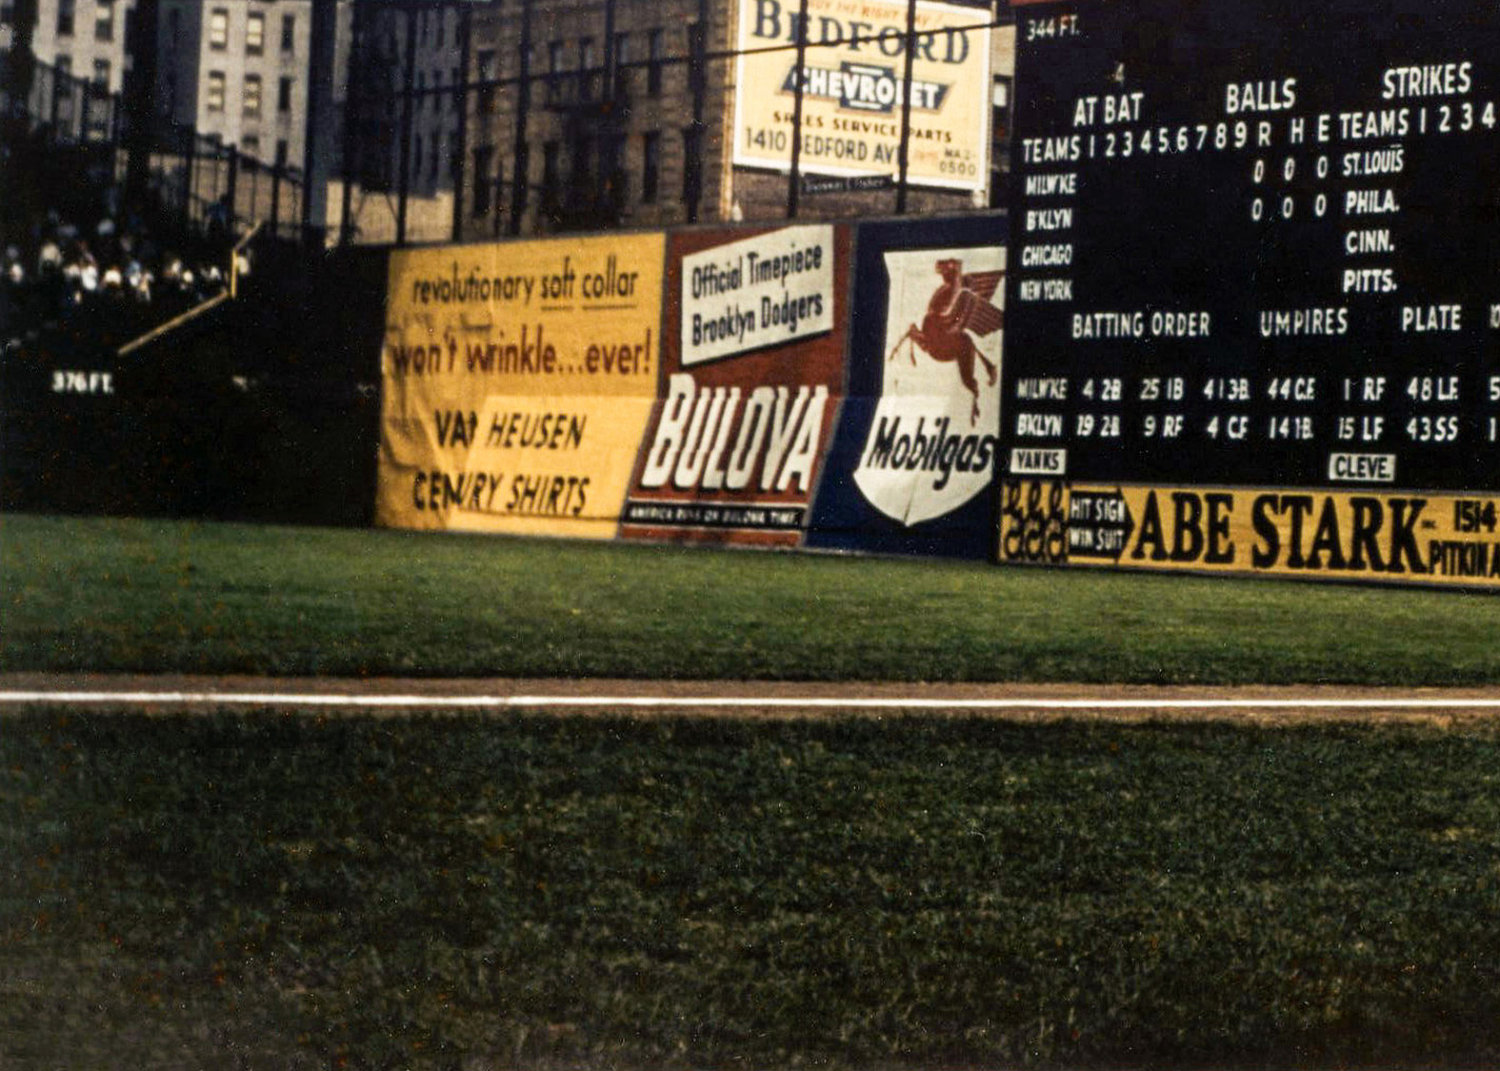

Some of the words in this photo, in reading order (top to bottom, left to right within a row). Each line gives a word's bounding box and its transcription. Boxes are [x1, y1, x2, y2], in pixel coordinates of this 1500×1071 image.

[1026, 18, 1056, 42] 344
[1225, 77, 1297, 114] BALLS
[1381, 61, 1472, 100] STRIKES
[832, 117, 898, 138] SERVICE
[1073, 96, 1098, 127] AT
[1104, 92, 1144, 125] BAT
[1339, 107, 1410, 139] TEAMS
[1420, 107, 1427, 134] 1
[1438, 105, 1451, 133] 2
[1460, 102, 1473, 131] 3
[1481, 101, 1496, 129] 4
[745, 127, 787, 153] 1410
[798, 134, 869, 162] EDFORD
[1022, 135, 1081, 163] TEAMS
[1089, 134, 1095, 158] 1
[1105, 132, 1116, 157] 2
[1122, 130, 1133, 157] 3
[1140, 129, 1152, 153] 4
[1158, 127, 1170, 152] 5
[1176, 126, 1189, 152] 6
[1196, 124, 1208, 150] 7
[1214, 122, 1227, 150] 8
[1234, 121, 1248, 149] 9
[1258, 121, 1272, 147] R
[1290, 117, 1305, 144] H
[1317, 113, 1331, 142] E
[1345, 189, 1400, 215] PHILA.
[1021, 243, 1073, 267] CHICAGO
[1345, 229, 1395, 254] CINN.
[412, 262, 535, 306] revolutionary
[540, 256, 576, 300] soft
[581, 255, 639, 299] collar
[692, 254, 743, 300] Official
[747, 242, 823, 289] Timepiece
[1043, 279, 1072, 301] YORK
[1342, 268, 1398, 293] PITTS.
[692, 302, 756, 347] Brooklyn
[760, 290, 824, 334] Dodgers
[1072, 311, 1144, 339] BATTING
[1151, 311, 1210, 337] ORDER
[1260, 307, 1348, 337] UMPIRES
[1402, 304, 1462, 332] PLATE
[486, 412, 588, 450] HEUSEN
[641, 374, 828, 491] BULOVA
[866, 416, 1002, 490] Mobilgas
[1014, 453, 1061, 472] YANKS
[1334, 456, 1392, 480] CLEVE.
[506, 474, 591, 516] SHIRTS
[1130, 489, 1236, 565] ABE
[1251, 493, 1430, 575] STARK
